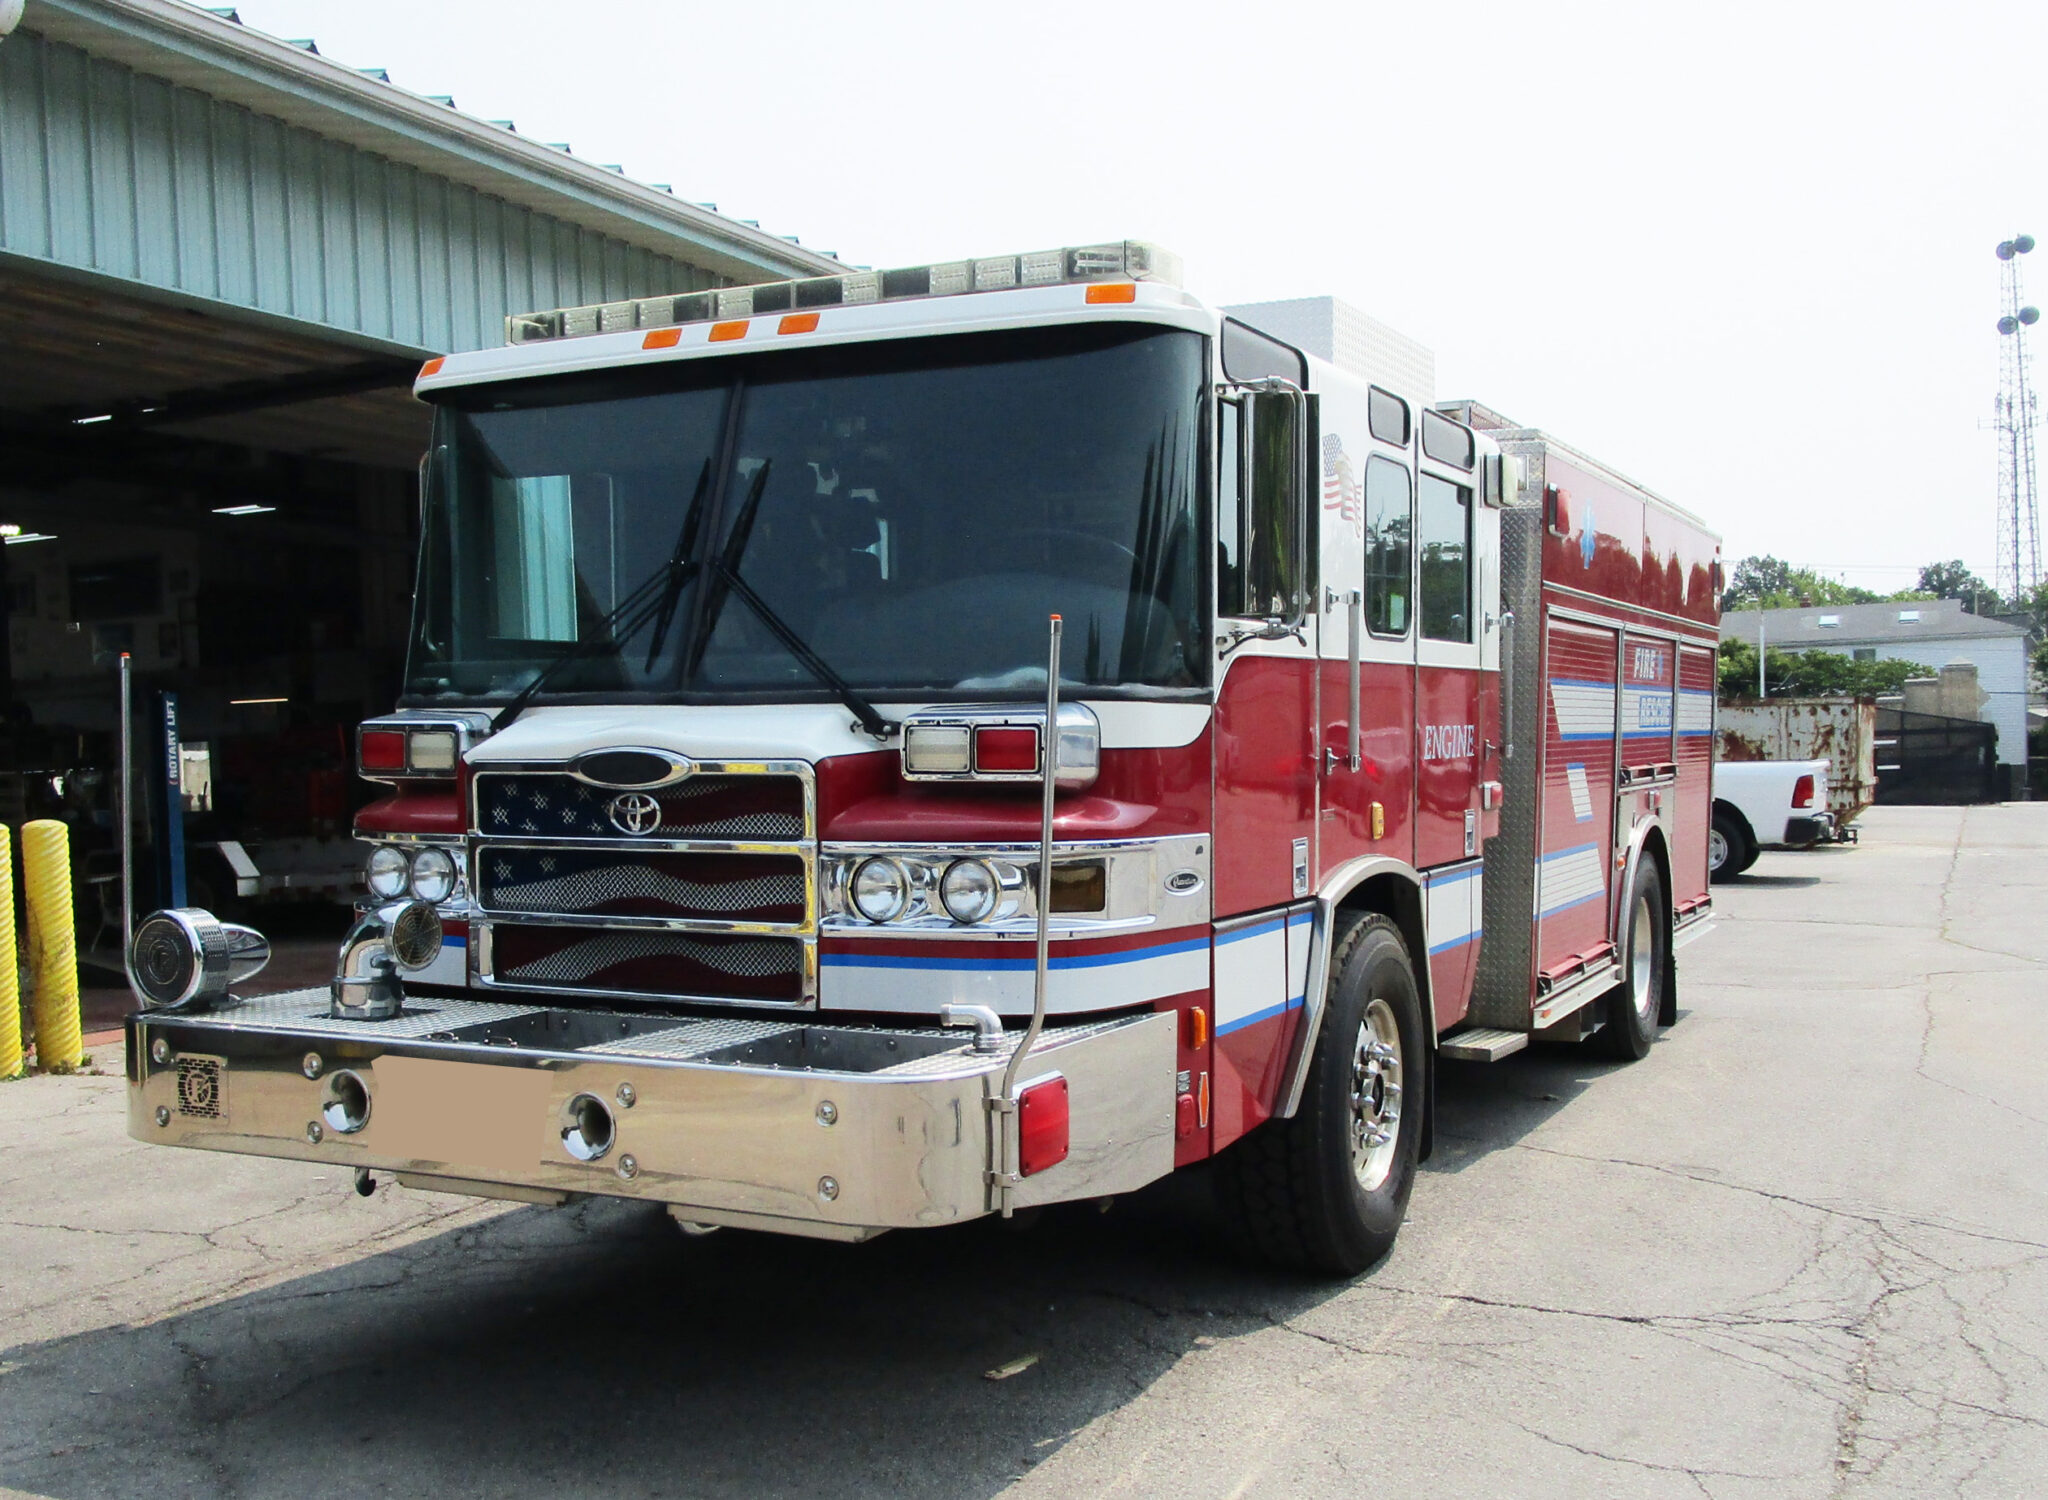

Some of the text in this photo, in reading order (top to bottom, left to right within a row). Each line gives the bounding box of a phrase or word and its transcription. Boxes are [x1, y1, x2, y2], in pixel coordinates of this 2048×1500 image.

[1633, 646, 1657, 680] FIRE
[166, 700, 177, 779] ROTARY LIFT
[1424, 725, 1474, 759] ENGINE
